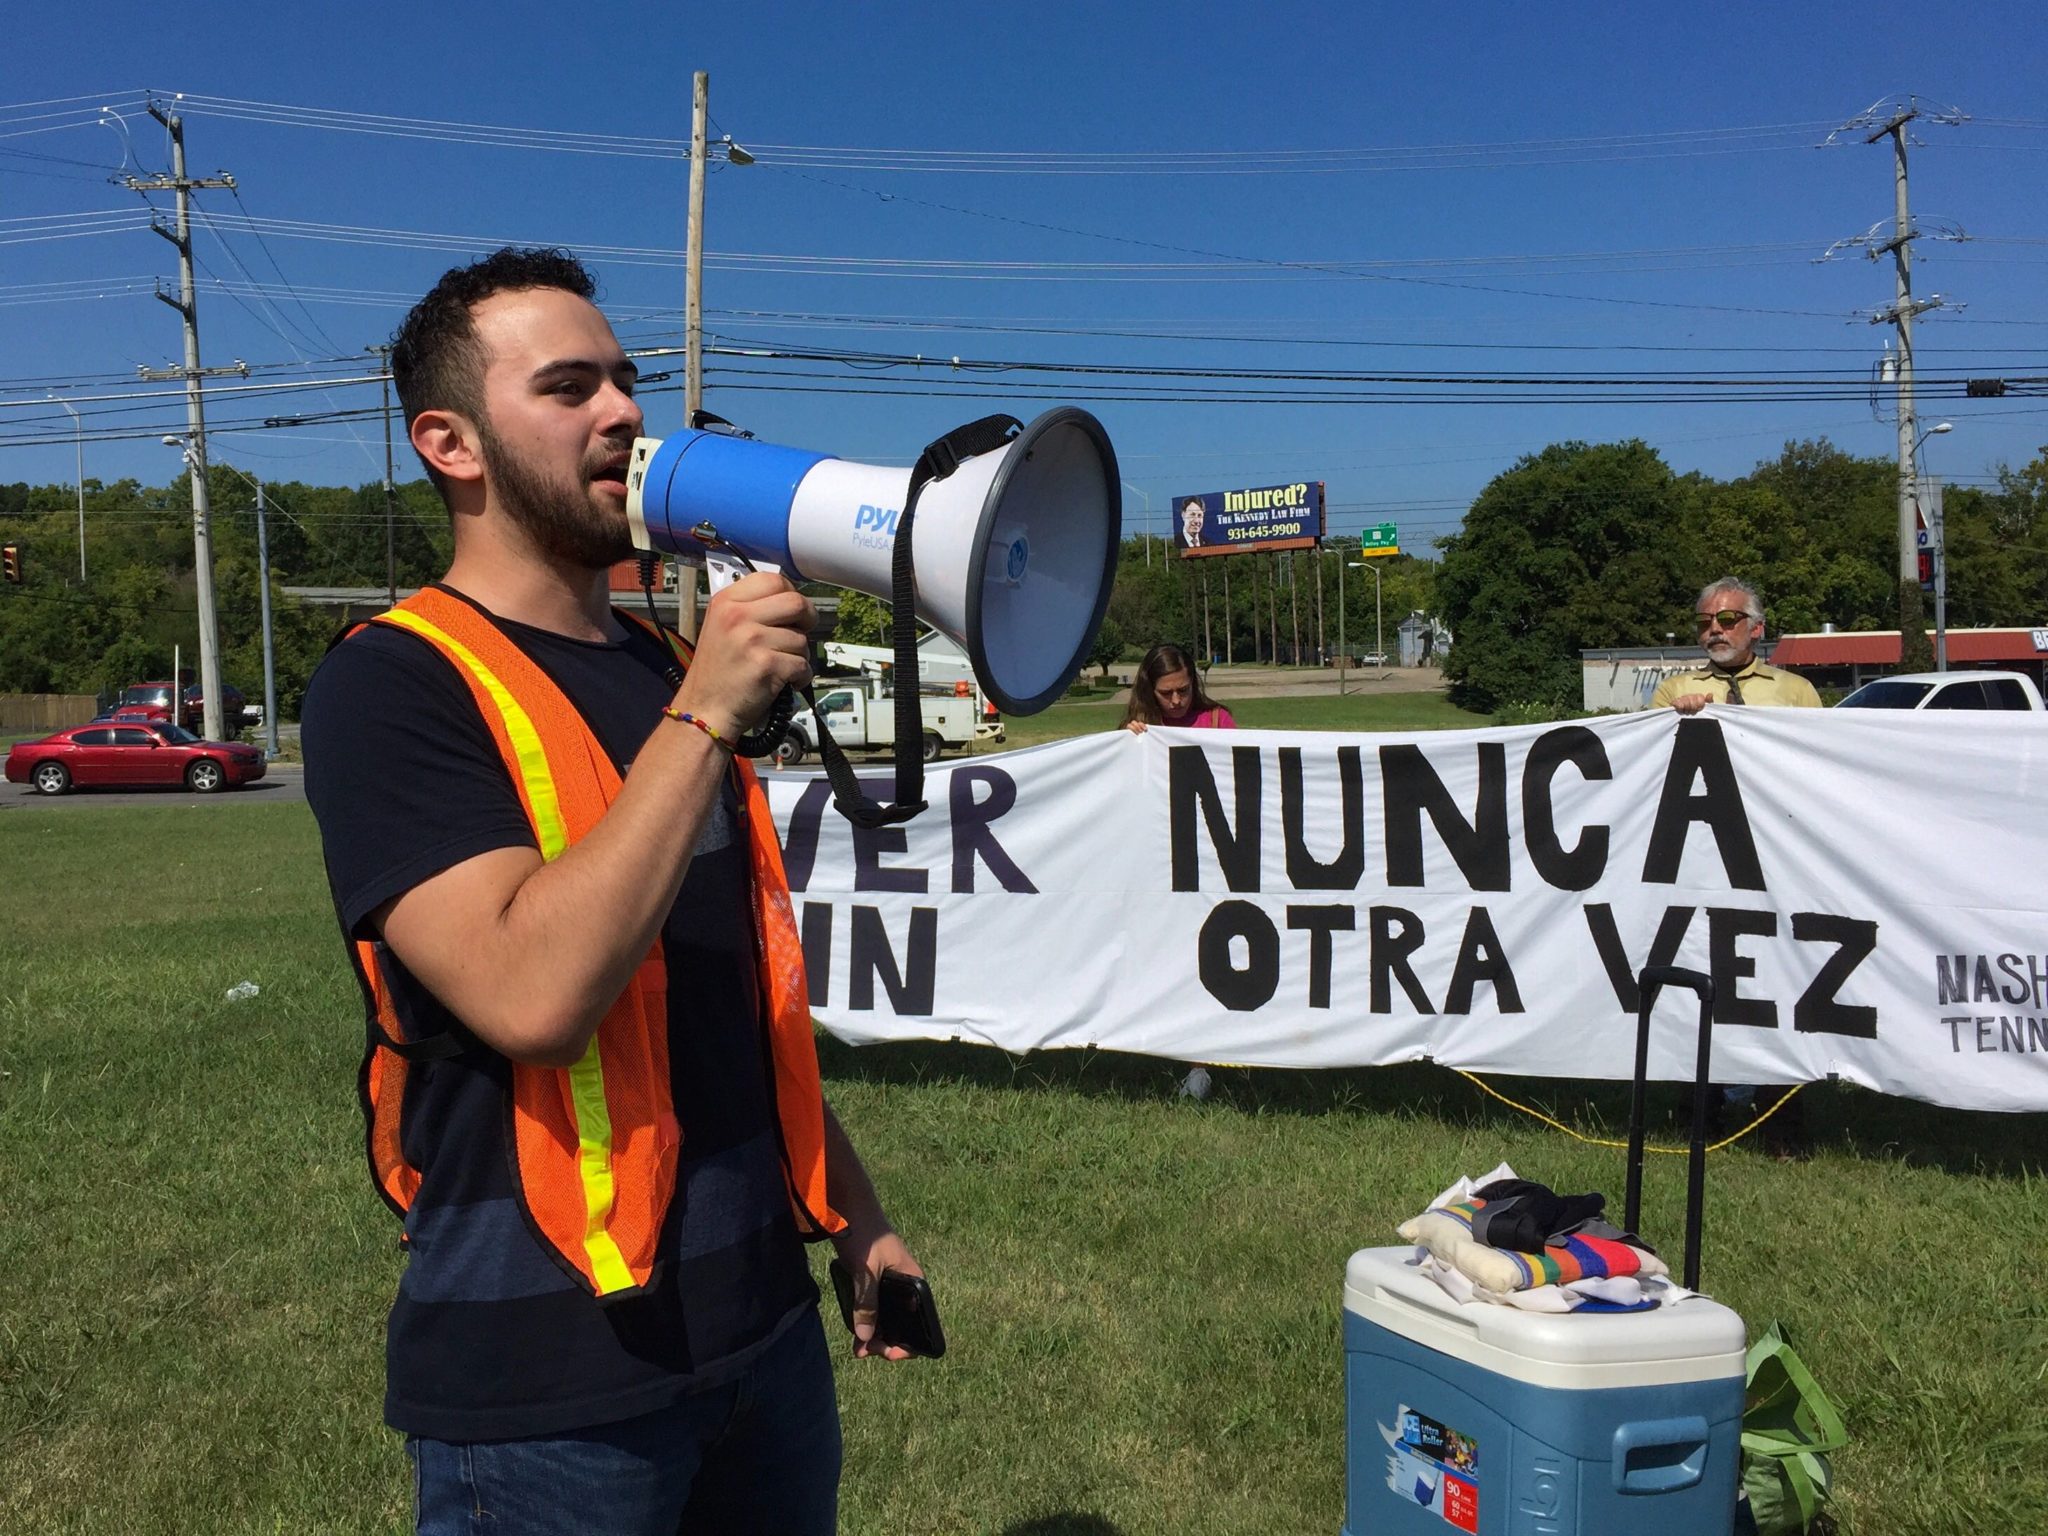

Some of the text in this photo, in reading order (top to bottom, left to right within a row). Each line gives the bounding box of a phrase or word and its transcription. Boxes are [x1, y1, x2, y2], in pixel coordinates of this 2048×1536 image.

[1223, 483, 1308, 513] Injured?
[1216, 514, 1233, 525] THE
[1233, 511, 1270, 523] KENNEDY
[1271, 508, 1288, 520] LAW
[1289, 506, 1311, 518] FIRM
[1227, 522, 1301, 541] 931-645-9900
[1169, 718, 1767, 893] NUNCA
[1198, 900, 1526, 1015] OTRA
[1583, 903, 1879, 1039] VEZ
[1940, 1016, 2048, 1053] TENN
[1446, 1480, 1460, 1497] 90
